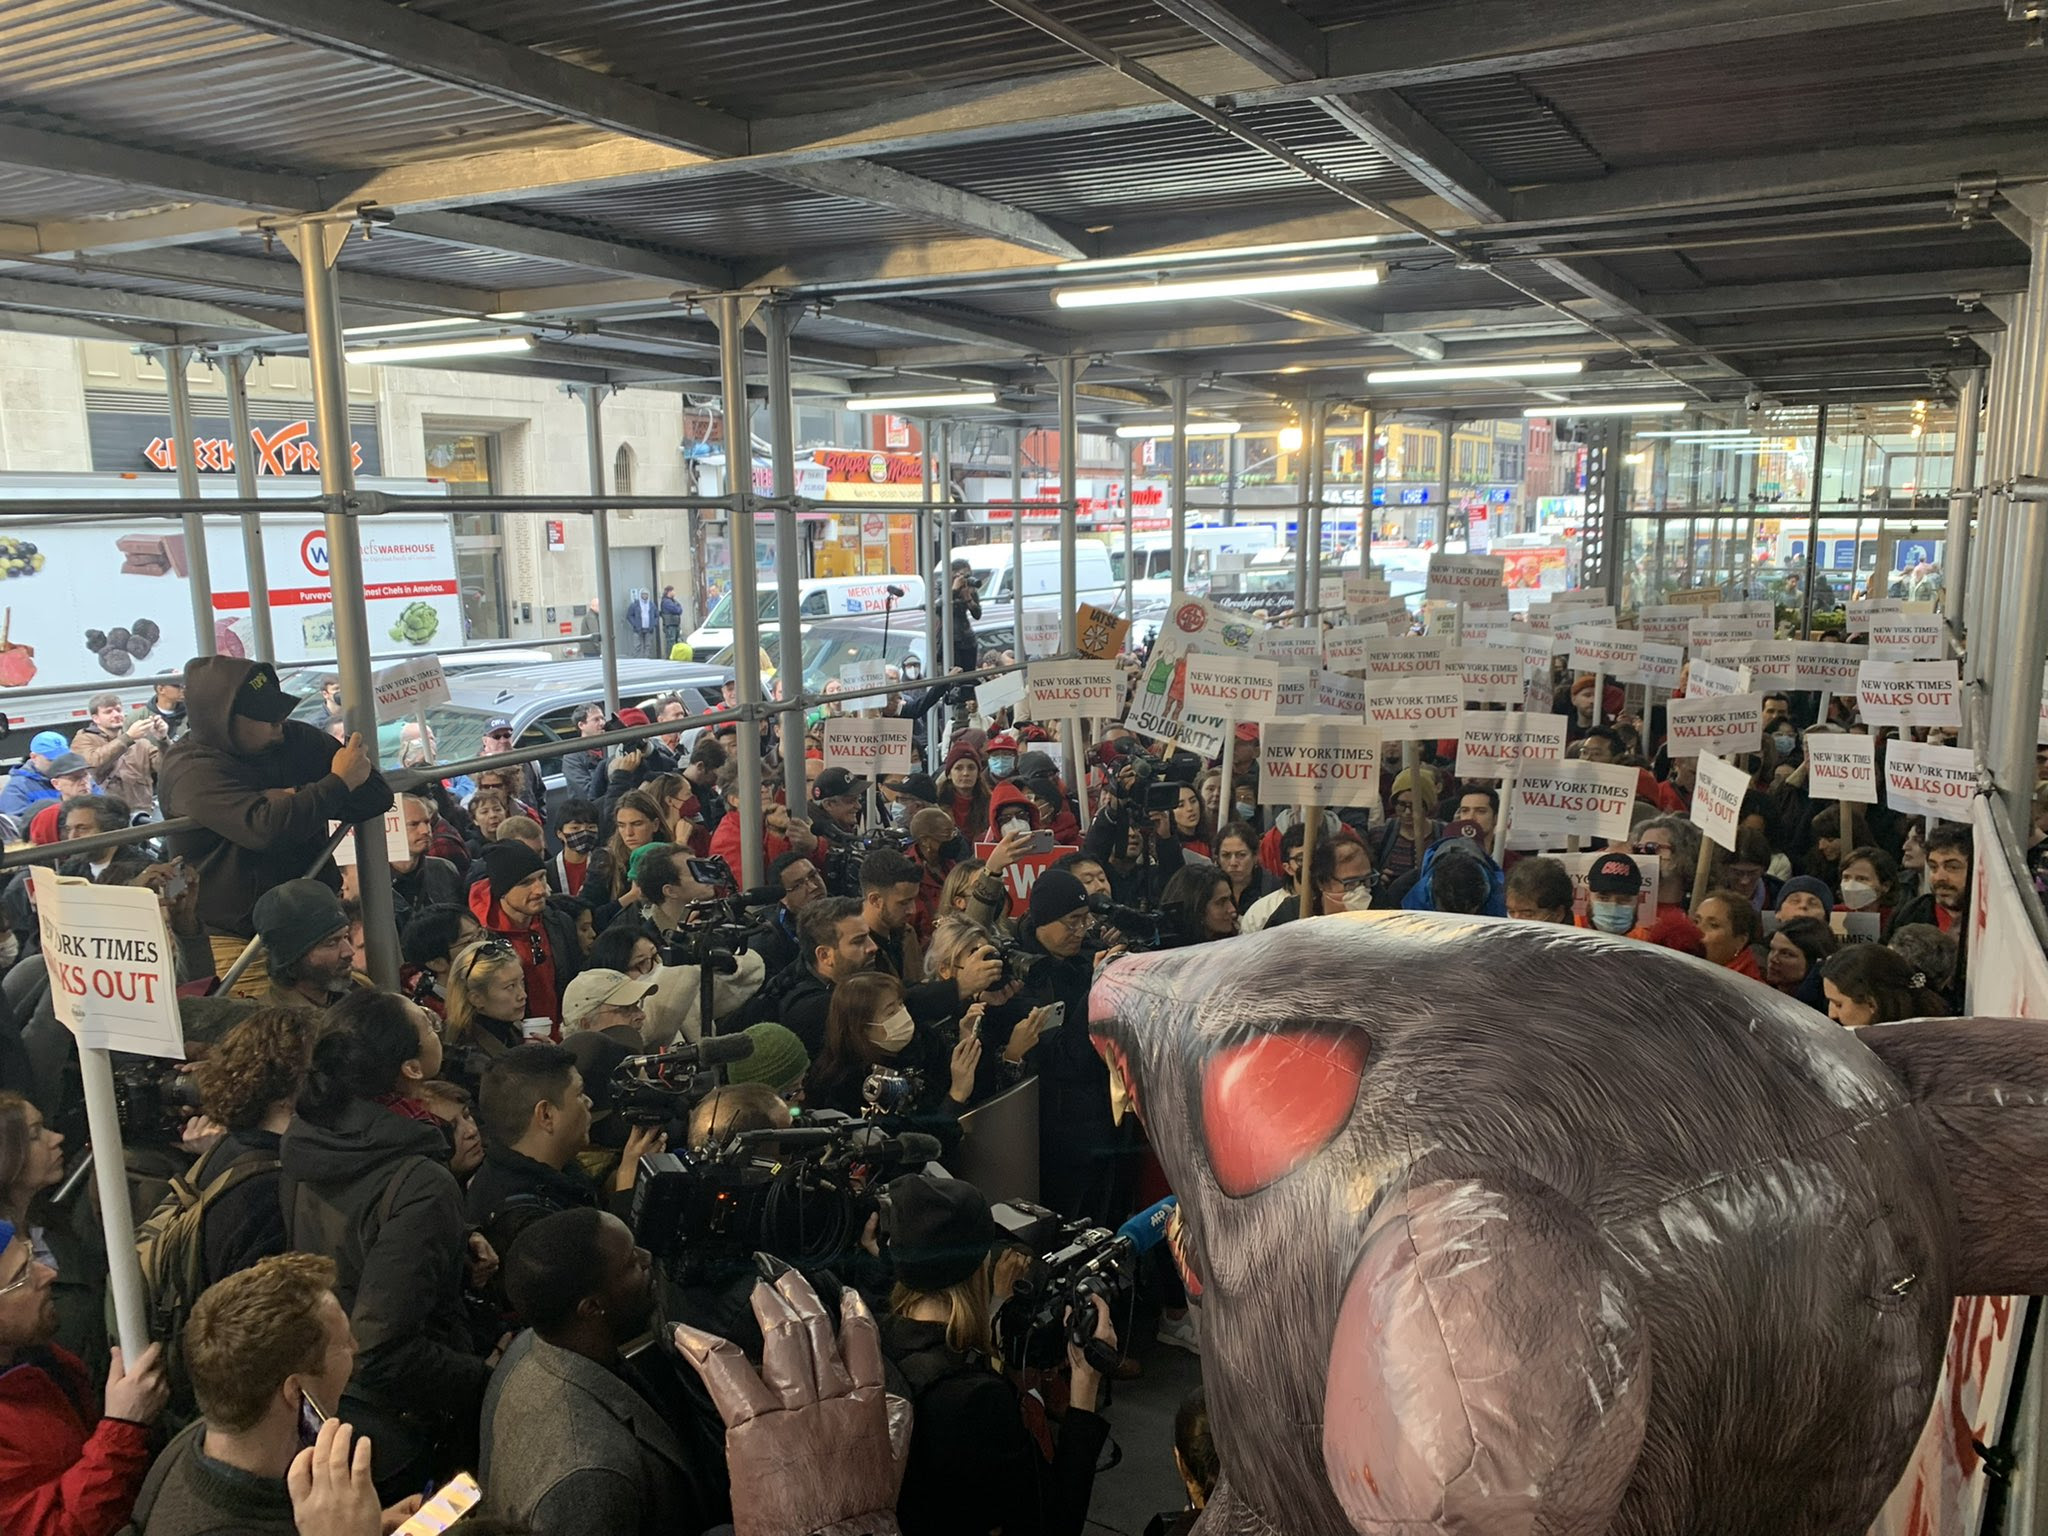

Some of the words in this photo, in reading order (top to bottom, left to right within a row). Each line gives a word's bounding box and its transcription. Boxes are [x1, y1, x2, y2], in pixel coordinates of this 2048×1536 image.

[250, 420, 363, 476] XPRS
[1431, 565, 1450, 574] NEW
[1452, 566, 1474, 575] YORK
[1476, 568, 1499, 576] TIMES
[1430, 574, 1470, 586] WALKS
[1473, 577, 1499, 588] OUT
[300, 592, 332, 601] Purveyo
[364, 587, 381, 596] inest
[1220, 596, 1264, 609] Breakfast
[1090, 609, 1118, 629] IATSE
[1531, 620, 1550, 629] WAL
[1756, 620, 1770, 628] UT
[1343, 638, 1363, 647] YORK
[1873, 635, 1910, 644] WALKS
[1912, 635, 1938, 644] OUT
[1294, 647, 1315, 656] OUT
[1329, 647, 1363, 658] WALKS
[1615, 643, 1638, 651] TIMES
[1370, 652, 1391, 660] NEW
[1392, 651, 1415, 659] YORK
[1575, 646, 1610, 660] WALKS
[1612, 652, 1637, 662] OUT
[1656, 656, 1678, 665] TIMES
[1714, 656, 1735, 665] NEW
[1736, 655, 1761, 664] YORK
[1763, 654, 1790, 663] TIMES
[1797, 655, 1813, 663] NEW
[1813, 656, 1839, 665] YORK
[1840, 657, 1860, 666] TIME
[1371, 661, 1413, 673] WALKS
[1445, 663, 1466, 671] NEW
[1467, 663, 1489, 672] YORK
[1490, 663, 1518, 672] TIMES
[1525, 656, 1547, 666] OUT
[1654, 665, 1677, 675] OUT
[1761, 664, 1790, 675] OUT
[1797, 665, 1836, 677] WALKS
[375, 682, 393, 694] NEW
[394, 676, 417, 688] YORK
[417, 669, 440, 681] TIMES
[1033, 678, 1055, 687] NEW
[1056, 677, 1082, 687] YORK
[1083, 676, 1111, 685] TIMES
[1190, 671, 1213, 681] NEW
[1214, 674, 1242, 685] YORK
[1243, 676, 1273, 687] TIMES
[1455, 674, 1488, 685] ALKS
[1490, 674, 1518, 685] OUT
[1861, 680, 1882, 689] NEW
[1882, 680, 1914, 690] YORK
[1915, 681, 1952, 690] TIMES
[378, 685, 418, 705] WALKS
[419, 677, 442, 694] OUT
[1034, 688, 1080, 701] WALKS
[1083, 687, 1112, 699] OUT
[1190, 683, 1238, 700] WALKS
[1241, 688, 1272, 702] OUT
[1336, 688, 1356, 698] YORK
[1370, 698, 1395, 707] NEW
[1396, 696, 1423, 706] YORK
[1425, 694, 1458, 704] TIMES
[1862, 692, 1913, 705] WALKS
[1917, 692, 1952, 705] OUT
[1371, 707, 1421, 721] WALKS
[1425, 706, 1458, 719] OUT
[1672, 715, 1698, 724] NEW
[1699, 714, 1726, 723] YORK
[1727, 711, 1757, 721] TIMES
[1138, 712, 1218, 750] SOLIDARITY
[1673, 725, 1724, 738] WALKS
[1727, 722, 1757, 734] OUT
[829, 734, 851, 743] NEW
[853, 734, 880, 743] YORK
[880, 733, 908, 743] TIMES
[1465, 731, 1493, 741] NEW
[1494, 732, 1522, 743] YORK
[1523, 733, 1560, 745] TIMES
[829, 744, 877, 756] WALKS
[878, 744, 906, 755] OUT
[1267, 747, 1296, 758] NEW
[1298, 747, 1334, 760] YORK
[1335, 749, 1374, 760] TIMES
[1465, 744, 1519, 759] WALKS
[1522, 746, 1559, 760] OUT
[1813, 752, 1831, 762] NEW
[1852, 754, 1871, 764] TIMES
[1267, 762, 1328, 778] WALKS
[1331, 764, 1373, 780] OUT
[1852, 767, 1872, 780] OUT
[1889, 761, 1915, 772] NEW
[1917, 764, 1943, 778] YORK
[1522, 778, 1552, 789] NEW
[1554, 781, 1589, 794] YORK
[1589, 784, 1629, 798] TIMES
[1890, 774, 1941, 794] WALKS
[1522, 791, 1583, 811] WALKS
[1586, 797, 1627, 815] OUT
[1717, 786, 1739, 807] TIMES
[1714, 801, 1735, 824] OUT
[90, 938, 158, 963] TIMES
[93, 969, 158, 1003] OUT
[1150, 1210, 1166, 1227] AFP
